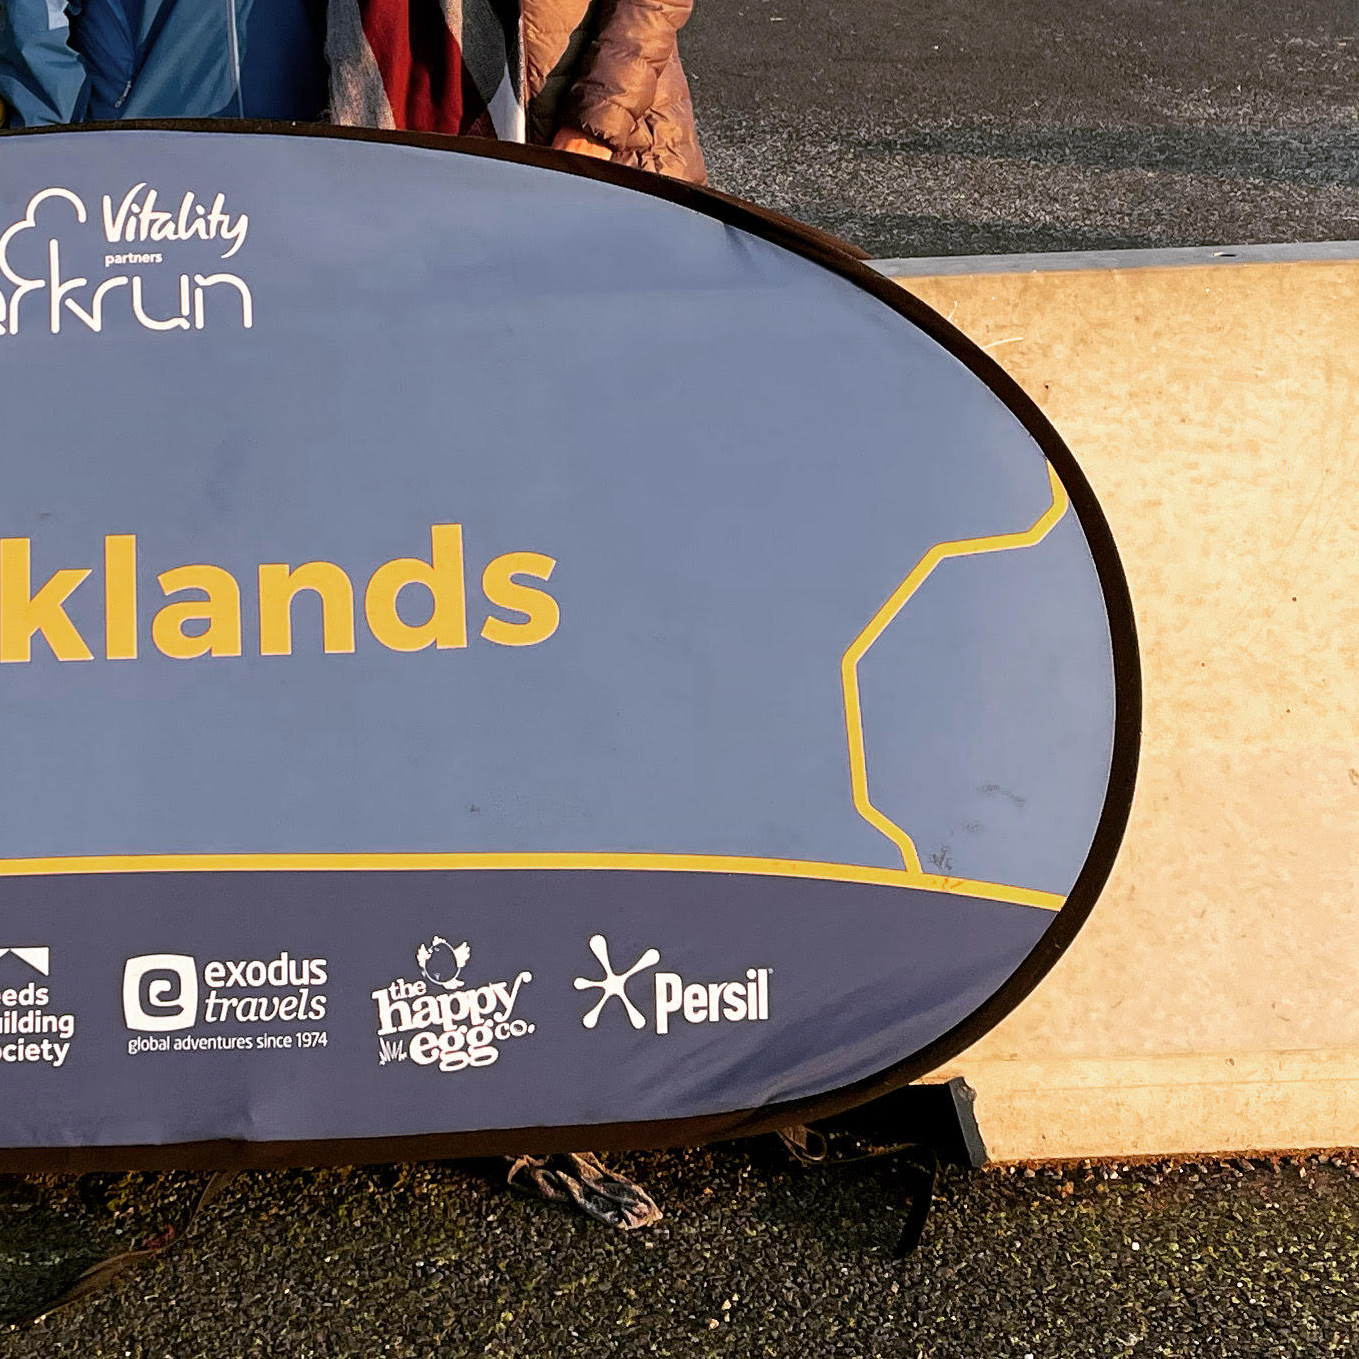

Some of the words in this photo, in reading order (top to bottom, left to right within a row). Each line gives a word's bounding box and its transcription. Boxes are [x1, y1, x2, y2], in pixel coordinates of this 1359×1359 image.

[103, 183, 248, 260] Vitality
[105, 253, 162, 267] partners
[205, 952, 327, 987] exodus
[205, 989, 326, 1022] travels
[372, 970, 534, 1036] happy
[389, 979, 427, 1000] the
[655, 969, 771, 1034] Persil
[129, 1036, 169, 1054] global
[174, 1035, 253, 1050] adventures
[257, 1033, 292, 1048] since
[296, 1032, 327, 1047] 1974
[409, 1022, 500, 1071] egg
[495, 1018, 535, 1039] co.
